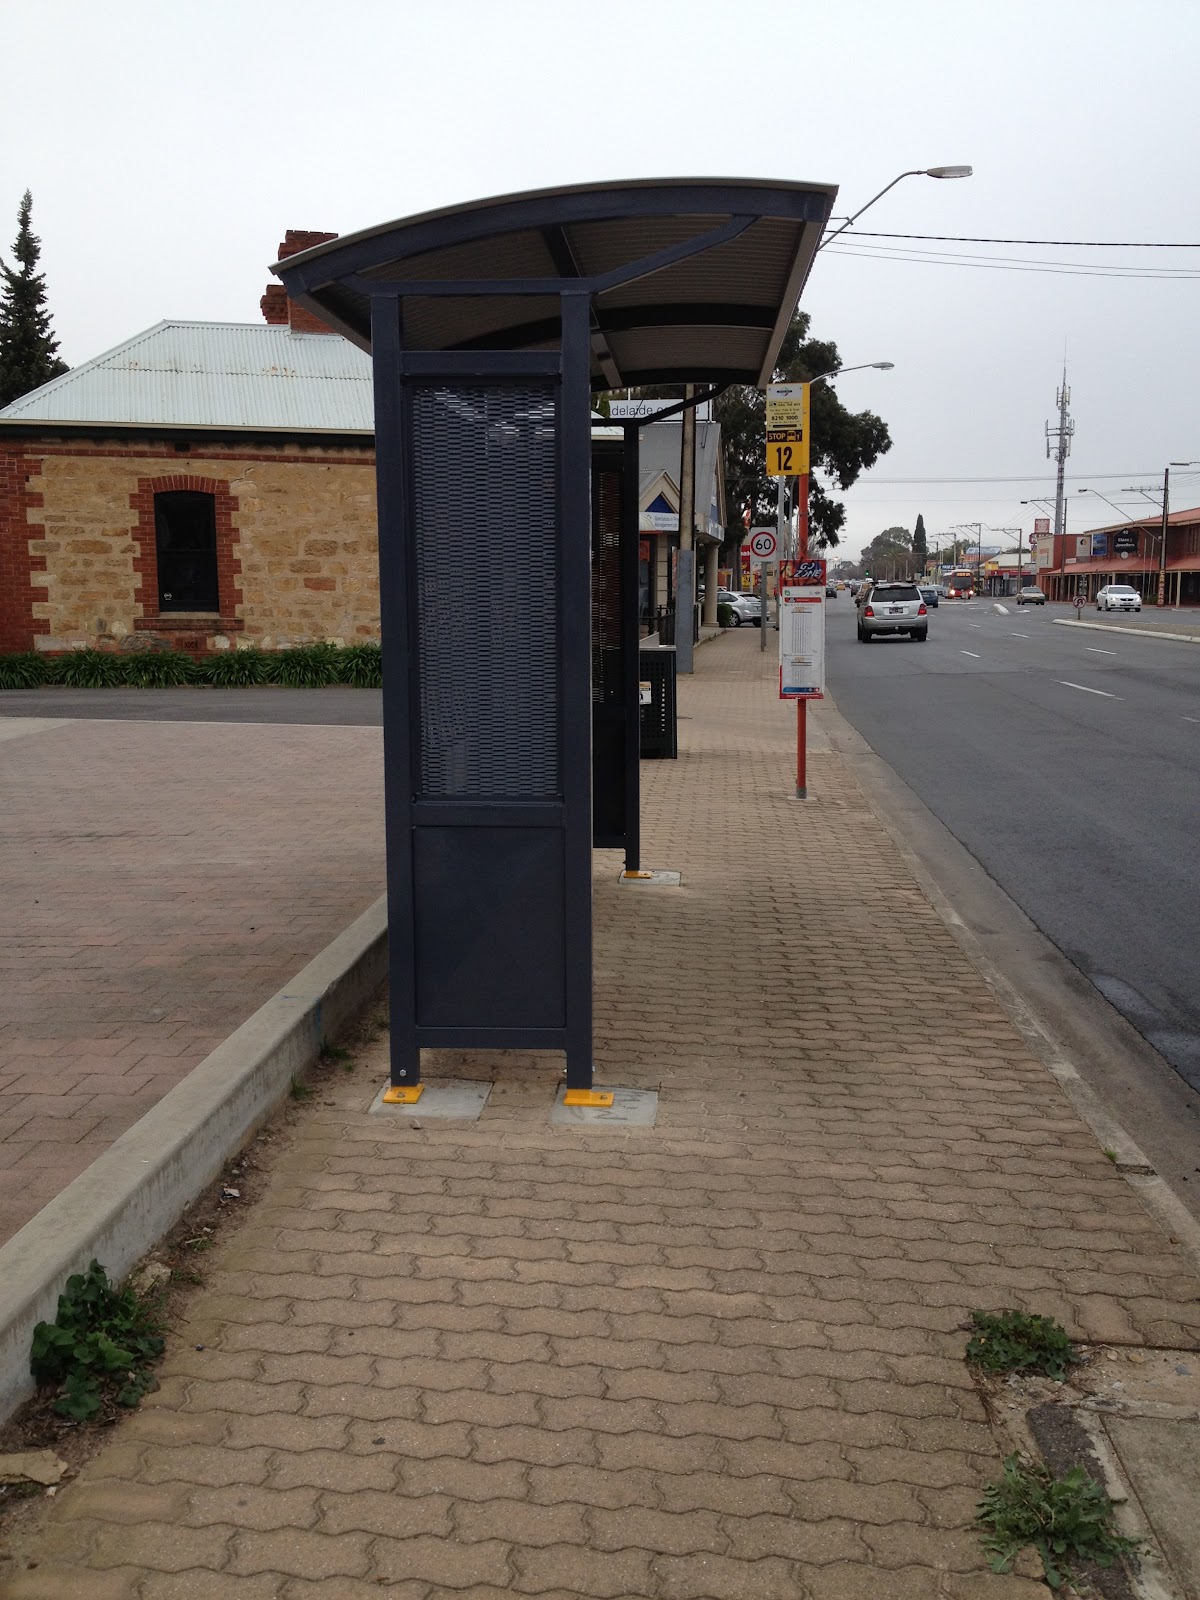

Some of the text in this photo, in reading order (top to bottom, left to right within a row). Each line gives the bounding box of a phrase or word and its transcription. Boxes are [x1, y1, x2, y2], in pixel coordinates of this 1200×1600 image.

[768, 432, 786, 440] STOP
[776, 446, 793, 471] 12
[755, 538, 772, 550] 60
[800, 562, 815, 570] GO
[794, 568, 822, 578] ZONE
